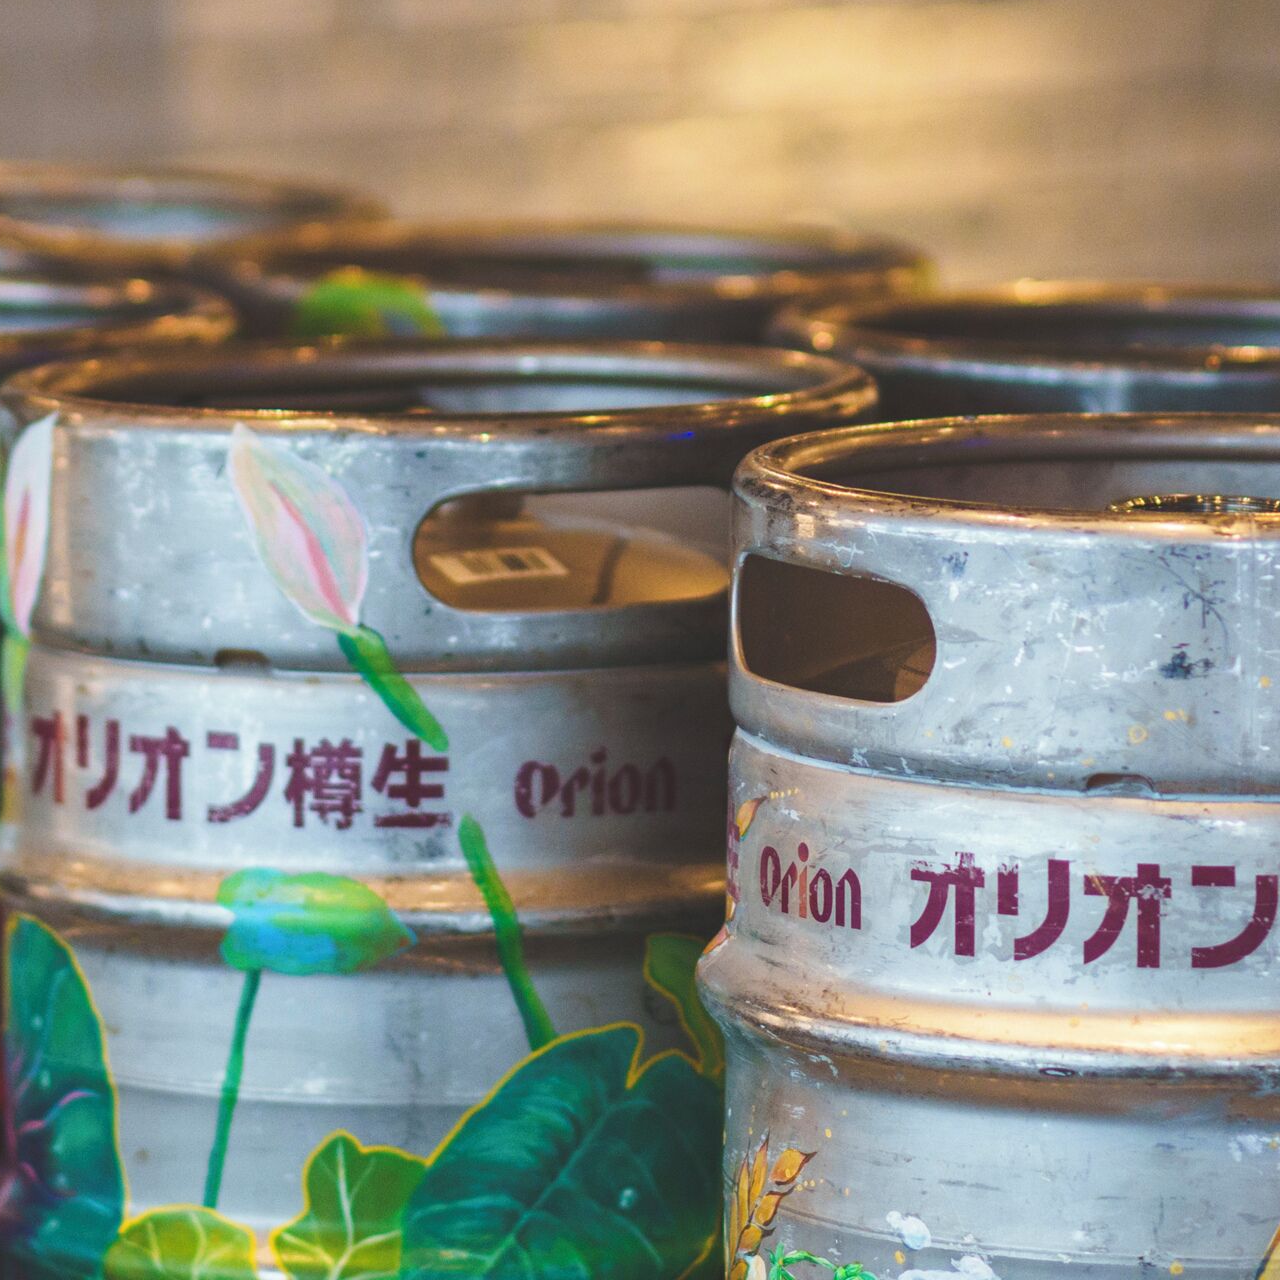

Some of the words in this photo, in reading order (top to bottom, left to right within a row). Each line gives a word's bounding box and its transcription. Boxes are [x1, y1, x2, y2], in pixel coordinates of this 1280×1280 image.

[31, 714, 452, 828] オリオン樽生
[515, 747, 677, 818] Orion
[760, 842, 862, 930] Orion
